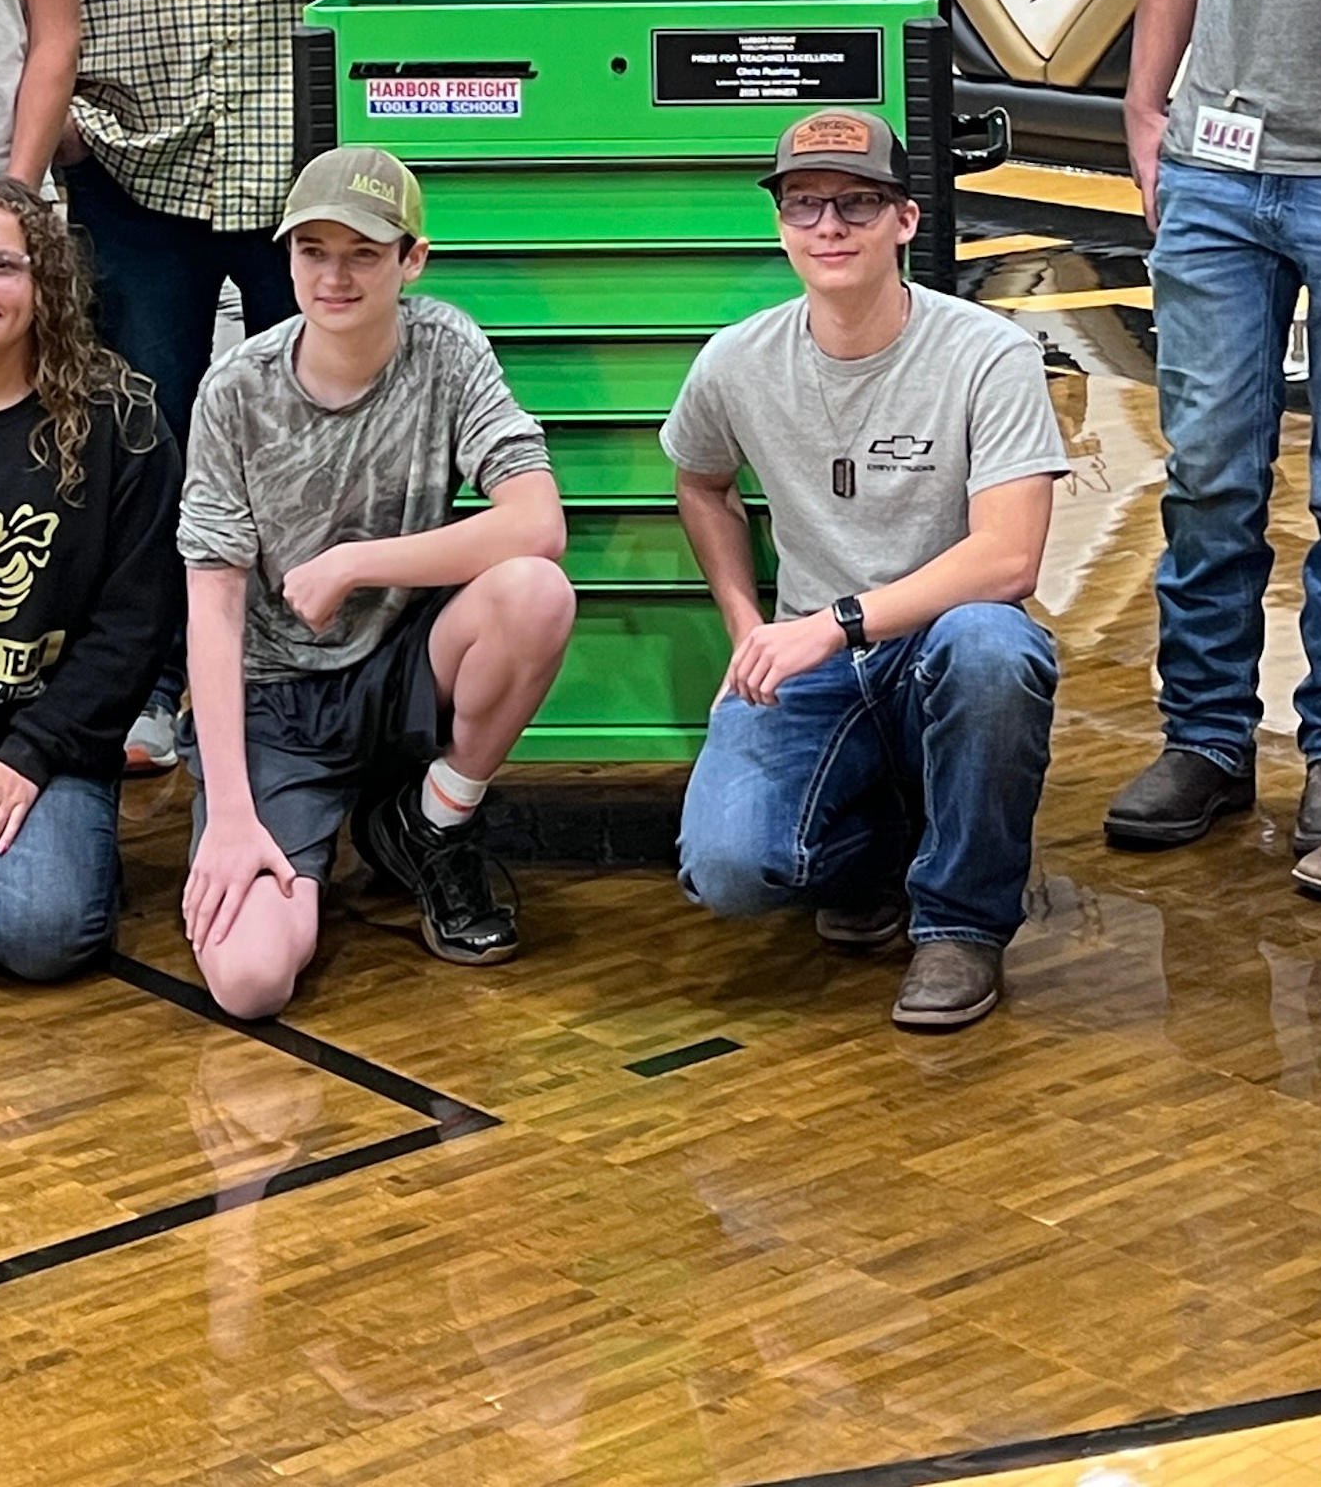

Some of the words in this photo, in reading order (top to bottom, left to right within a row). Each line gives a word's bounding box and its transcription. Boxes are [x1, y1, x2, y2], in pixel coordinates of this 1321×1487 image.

[370, 82, 440, 97] HARBOR
[447, 82, 518, 97] FREIGHT
[374, 102, 418, 113] TOOLS
[422, 102, 448, 113] FOR
[451, 101, 515, 113] SCHOOLS
[351, 173, 395, 198] MCM
